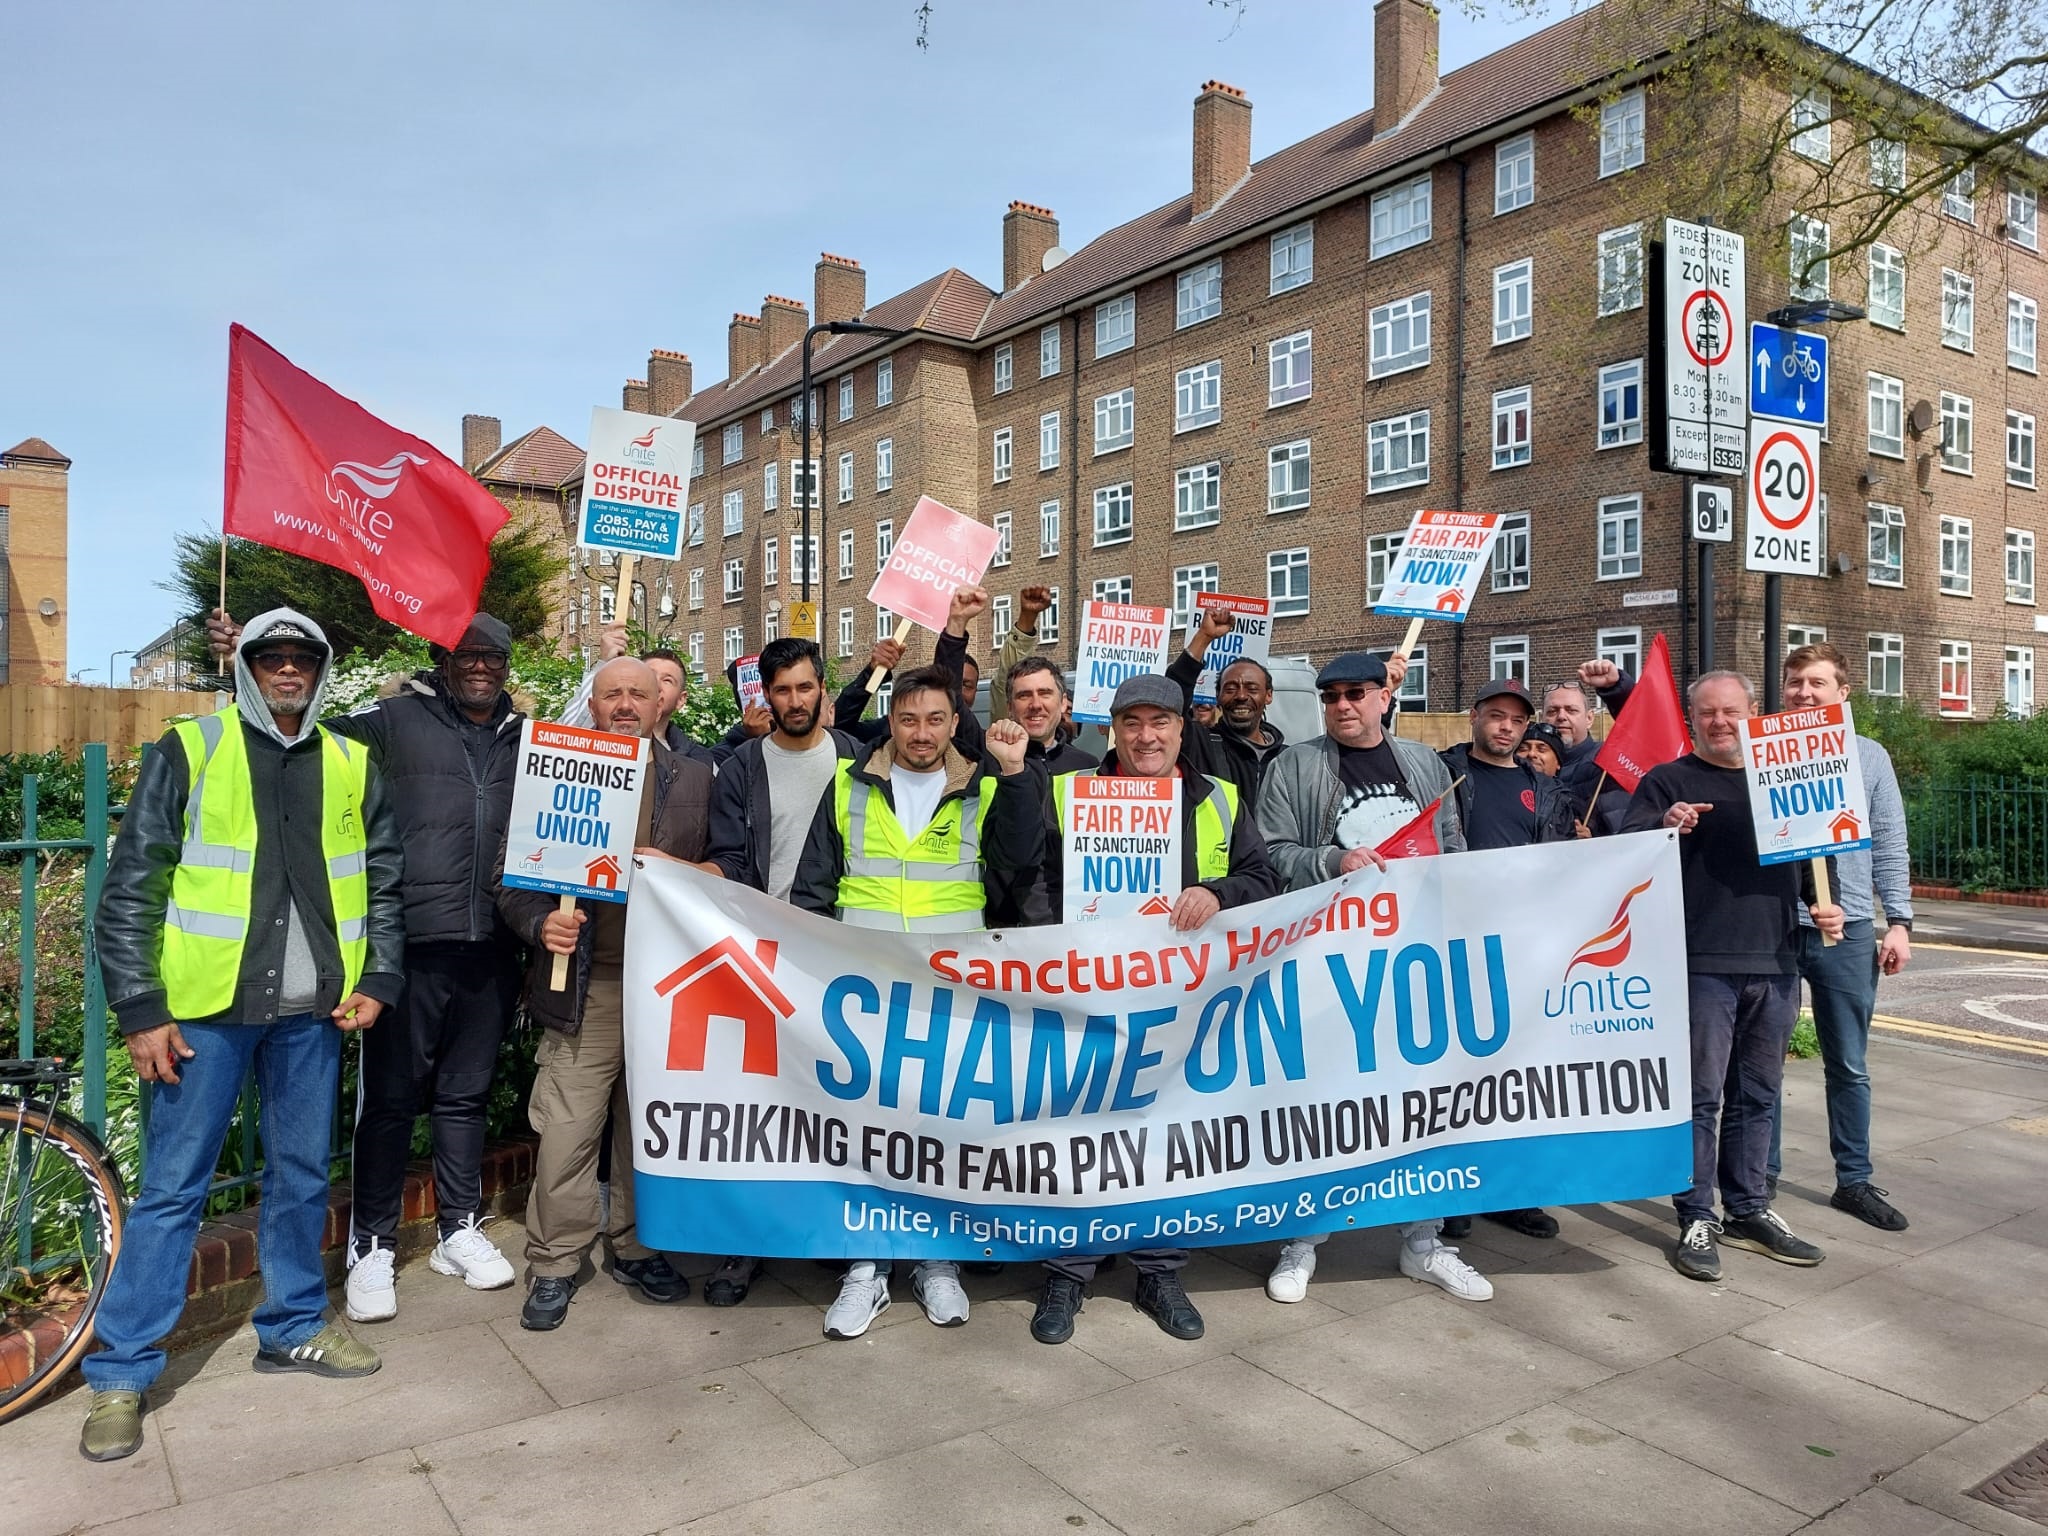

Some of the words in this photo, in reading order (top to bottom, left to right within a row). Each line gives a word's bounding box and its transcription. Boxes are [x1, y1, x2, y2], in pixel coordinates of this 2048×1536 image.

[1673, 225, 1739, 250] PEDESTRIAN
[1679, 245, 1696, 256] and
[1699, 247, 1734, 264] CYCLE
[1682, 261, 1730, 288] ZONE
[1688, 369, 1707, 383] Mon
[1717, 373, 1729, 385] Fri
[1673, 384, 1696, 398] 8.30
[1730, 394, 1742, 405] am
[1689, 402, 1695, 414] 3
[1714, 407, 1728, 417] pm
[1675, 426, 1708, 443] Except
[1713, 433, 1741, 446] permit
[1673, 446, 1707, 461] holders
[1714, 449, 1742, 468] SS36
[593, 463, 683, 490] OFFICIAL
[1764, 458, 1806, 500] 20
[594, 482, 678, 507] DISPUTE
[597, 514, 631, 528] JOBS,
[635, 519, 657, 530] PAY
[660, 523, 668, 533] &
[1431, 513, 1443, 523] ON
[1446, 514, 1486, 526] STRIKE
[593, 524, 669, 543] CONDITIONS
[1409, 528, 1451, 546] FAIR
[1453, 530, 1491, 549] PAY
[1405, 547, 1418, 557] AT
[1419, 548, 1482, 562] SANCTUARY
[1754, 535, 1811, 563] ZONE
[900, 540, 978, 585] OFFICIAL
[1401, 560, 1468, 587] NOW!
[891, 556, 959, 596] DISPUT
[1102, 605, 1115, 617] ON
[1118, 607, 1154, 622] STRIKE
[1199, 598, 1236, 609] SANCTUARY
[1237, 602, 1264, 612] HOUSING
[264, 628, 304, 637] adidas
[1087, 622, 1125, 646] FAIR
[1130, 626, 1163, 649] PAY
[1193, 612, 1267, 636] RNISE
[1086, 646, 1099, 657] AT
[1101, 647, 1160, 664] SANCTUARY
[1211, 635, 1243, 653] OUR
[741, 670, 760, 683] WAG
[743, 682, 761, 696] DOW
[1762, 718, 1781, 734] ON
[1783, 709, 1829, 731] STRIKE
[537, 730, 592, 749] SANCTUARY
[593, 739, 633, 756] HOUSING
[1752, 738, 1801, 768] FAIR
[1806, 729, 1846, 759] PAY
[526, 752, 636, 791] RECOGNISE
[1758, 771, 1772, 787] AT
[1775, 758, 1849, 784] SANCTUARY
[553, 783, 602, 817] OUR
[1089, 780, 1107, 796] ON
[1110, 780, 1157, 797] STRIKE
[1769, 777, 1846, 820] NOW!
[536, 811, 610, 849] UNION
[1073, 804, 1123, 832] FAIR
[1130, 806, 1173, 834] PAY
[1074, 836, 1090, 853] AT
[1093, 837, 1171, 854] SANCTUARY
[1083, 856, 1161, 894] NOW!
[576, 887, 614, 898] CONDITIONS
[929, 944, 1211, 994] Sanctuary
[1227, 892, 1400, 971] Housing
[816, 974, 1178, 1125] SHAME
[1184, 959, 1306, 1093] ON
[1325, 934, 1511, 1073] YOU
[1570, 1016, 1654, 1037] theUNION
[643, 1100, 849, 1168] STRIKING
[861, 1126, 945, 1186] FOR
[958, 1141, 1058, 1195] FAIR
[1070, 1127, 1148, 1195] PAY
[1165, 1115, 1250, 1182] AND
[1261, 1095, 1389, 1166] UNION
[1402, 1057, 1670, 1143] RECOGNITION
[843, 1200, 939, 1238] Unite,
[1088, 1219, 1137, 1242] for
[1143, 1209, 1225, 1239] Jobs,
[1235, 1201, 1288, 1228] Pay
[1295, 1192, 1316, 1217] &
[1324, 1165, 1481, 1209] Conditions
